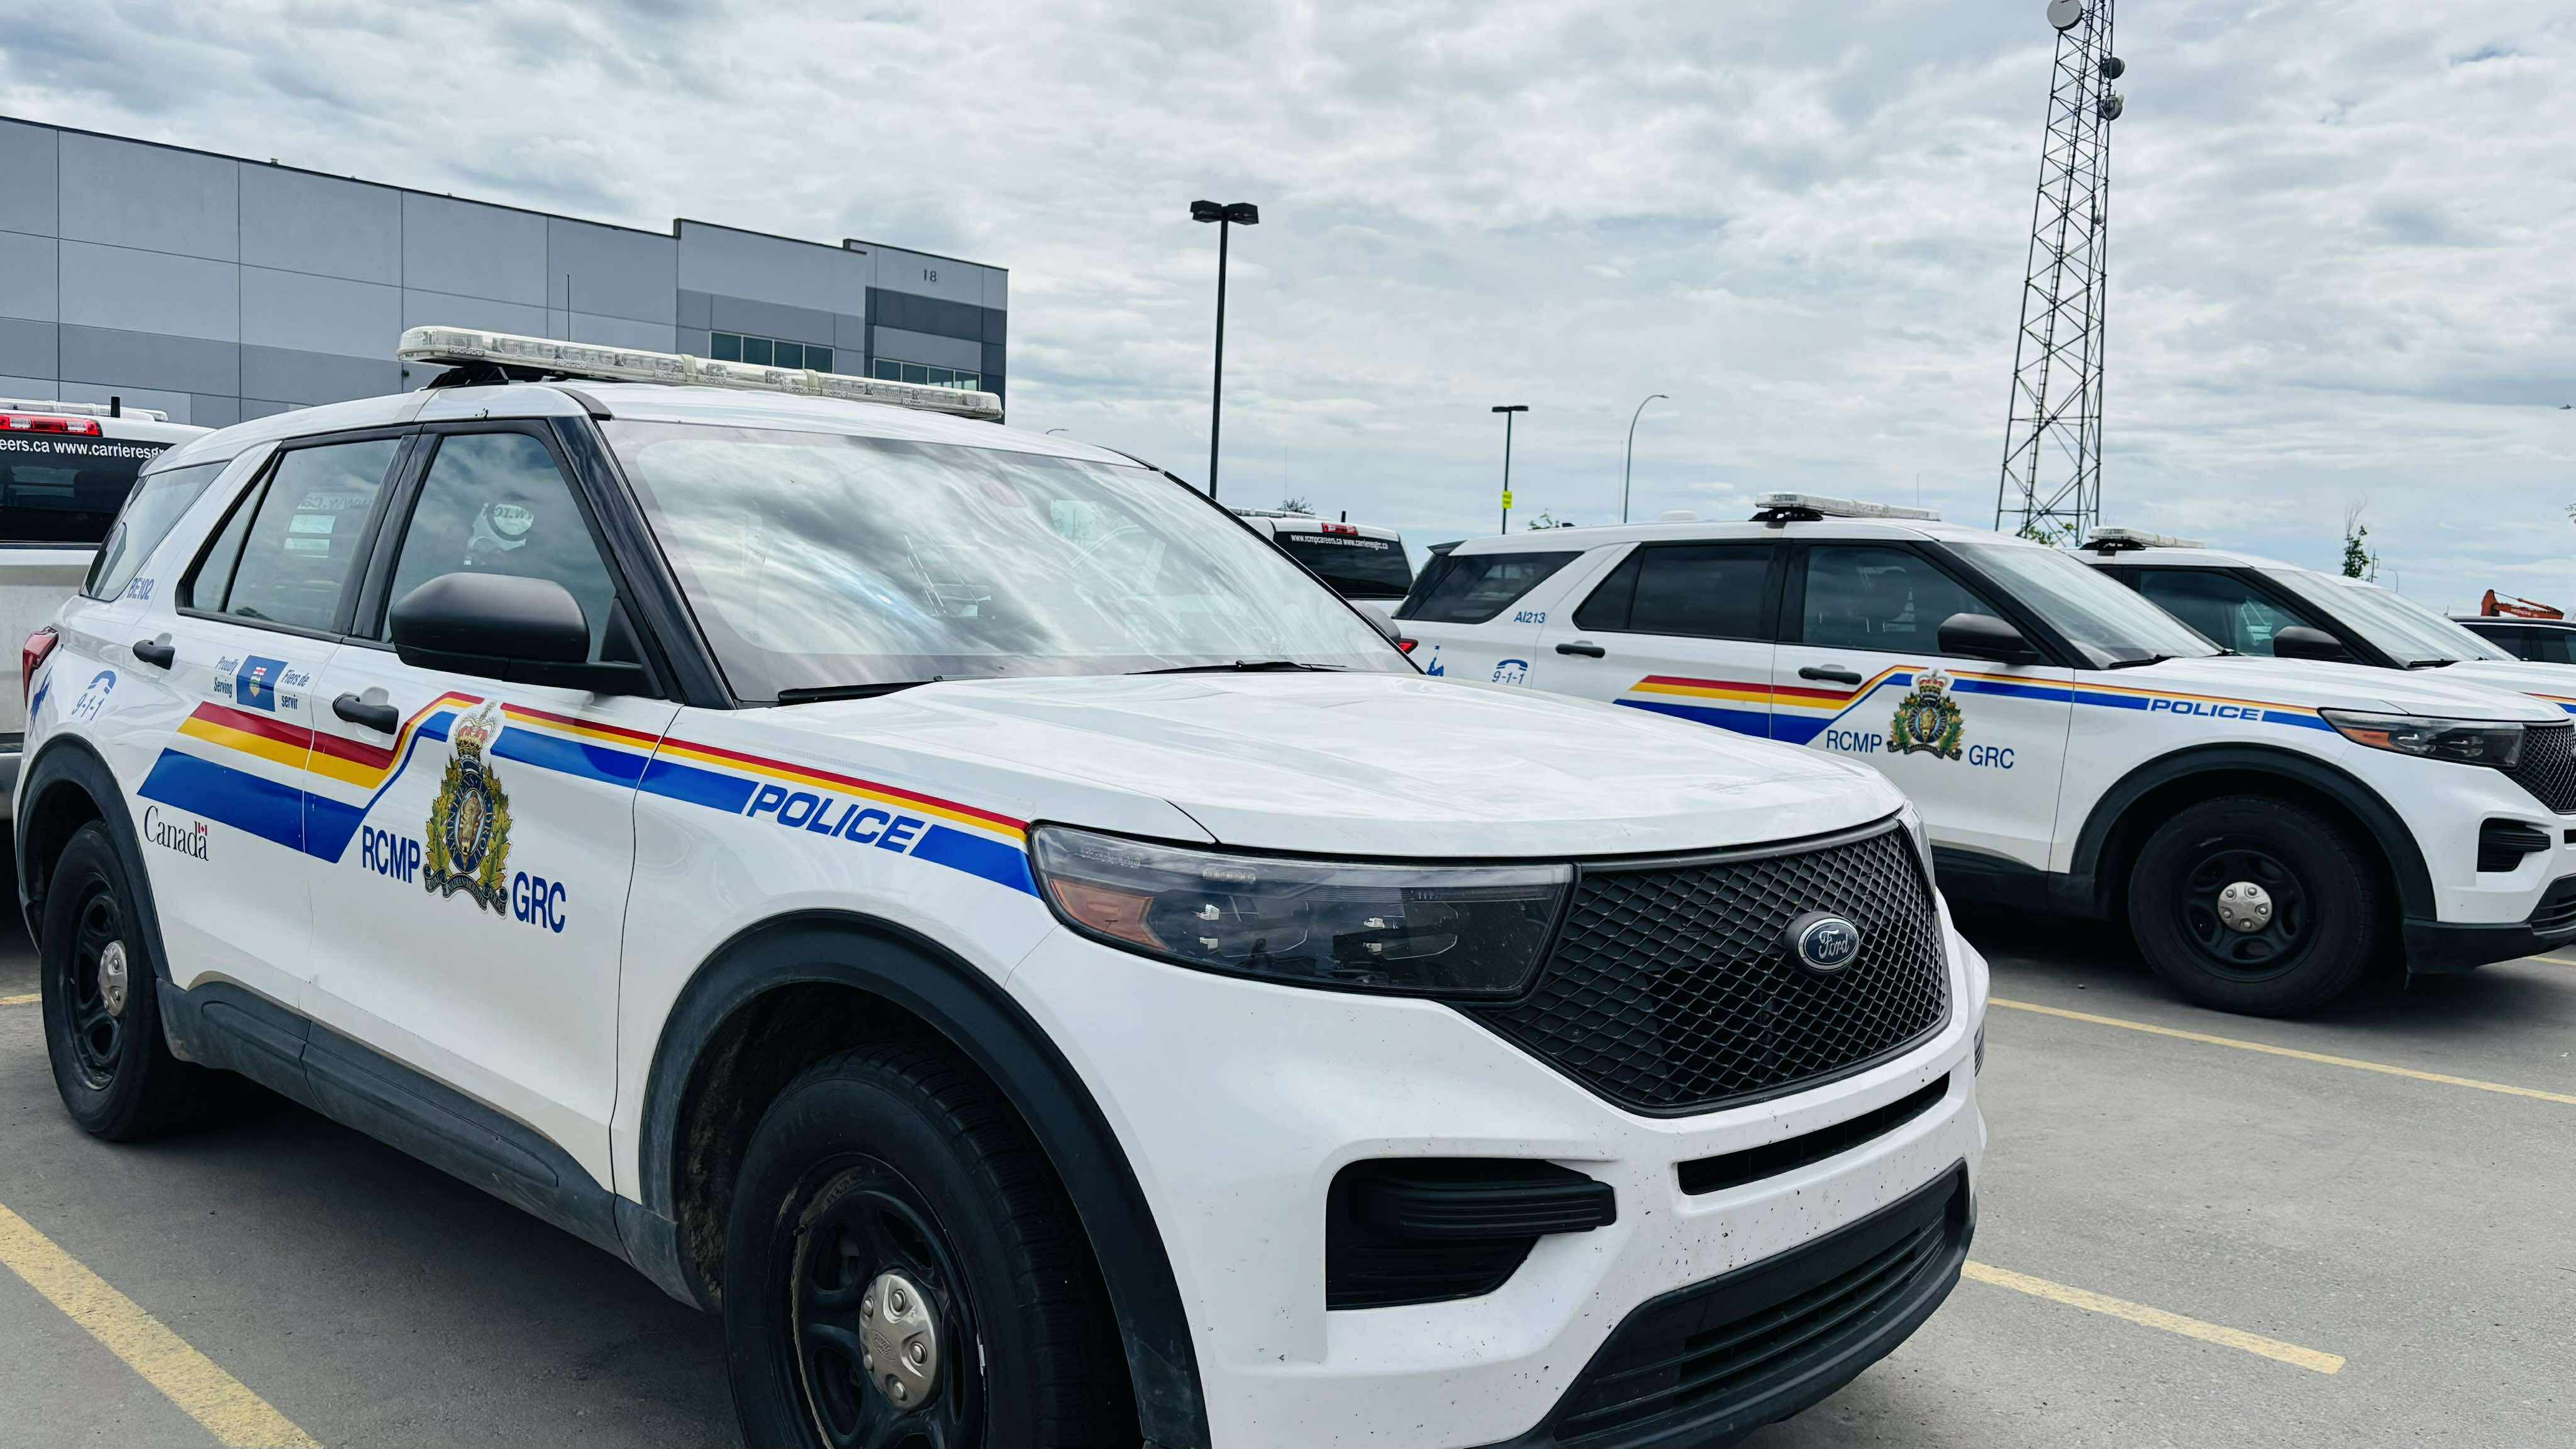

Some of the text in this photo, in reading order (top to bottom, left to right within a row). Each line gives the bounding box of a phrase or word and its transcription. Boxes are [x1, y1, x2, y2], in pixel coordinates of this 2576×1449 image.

[924, 269, 936, 282] 18
[1291, 534, 1389, 551] www.rcmpcareers.ca www.carrieresgrc.ca
[126, 577, 155, 600] BE102
[1514, 611, 1546, 624] AI213
[213, 676, 233, 699] Serving
[280, 669, 310, 687] Fiers de
[1492, 670, 1525, 685] 9-1-1
[71, 692, 105, 721] 9-1-1
[281, 694, 298, 709] servir
[2151, 699, 2260, 721] POLICE
[1827, 730, 1882, 755] RCMP
[1968, 745, 2015, 770] GRC
[747, 784, 925, 853] POLICE
[144, 805, 209, 862] Canada
[362, 824, 566, 934] RCMP GRC
[1818, 929, 1851, 960] Ford
